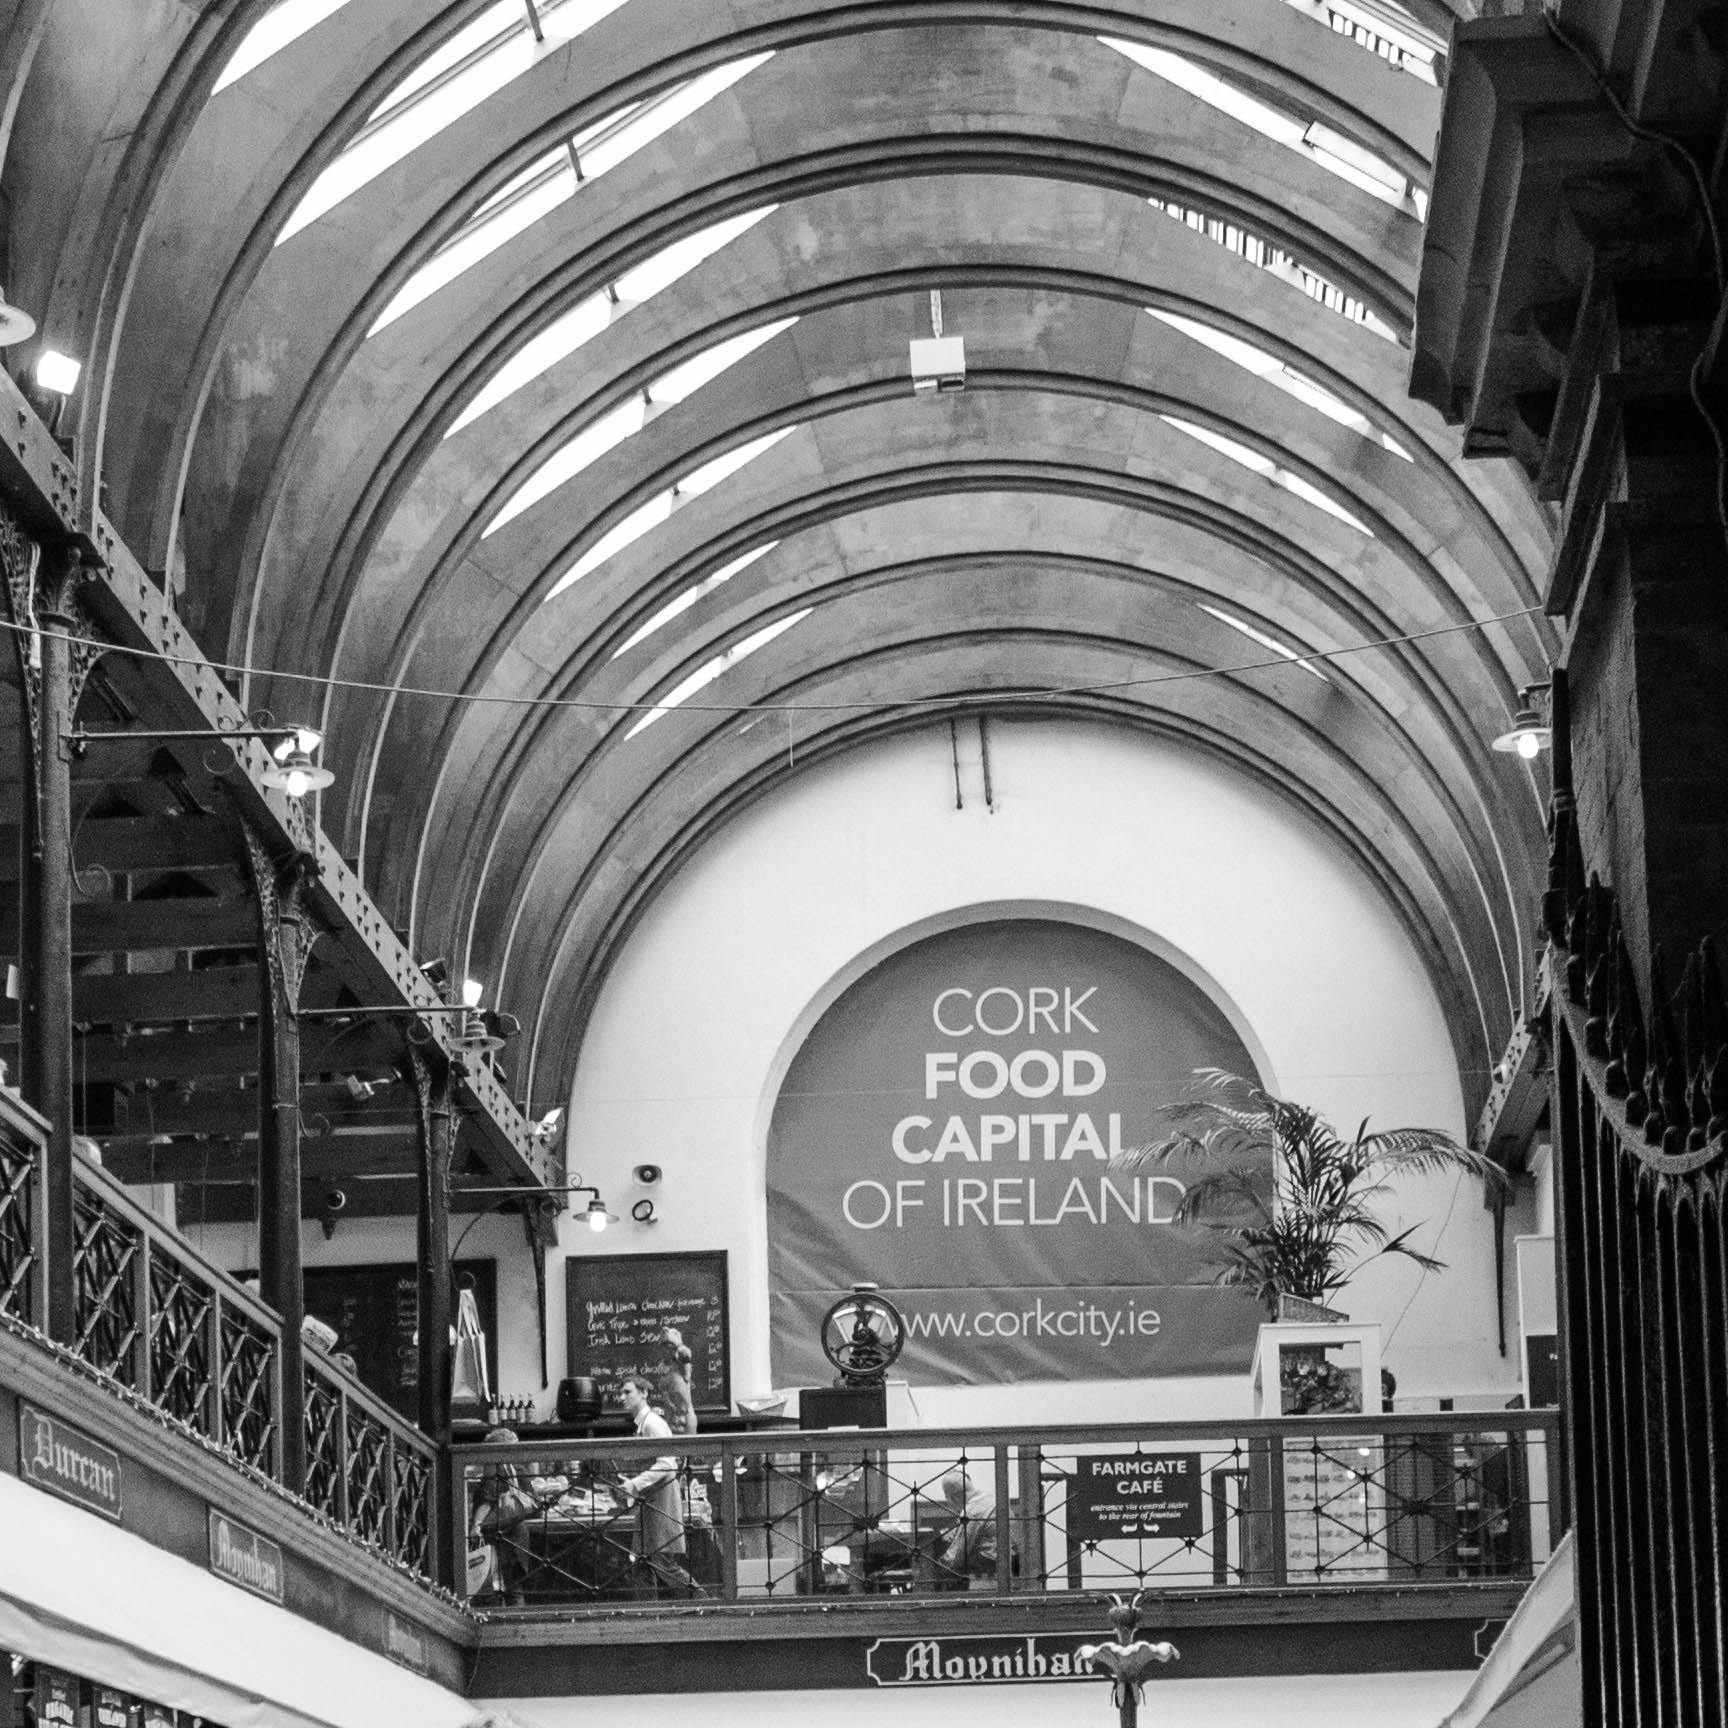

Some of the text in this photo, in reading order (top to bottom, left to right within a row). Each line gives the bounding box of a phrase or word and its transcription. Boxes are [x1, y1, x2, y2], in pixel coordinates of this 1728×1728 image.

[932, 986, 1100, 1037] CORK
[925, 1049, 1108, 1100] FOOD
[842, 1175, 1188, 1230] OF IRELAND
[1092, 1460, 1188, 1476] FARMGATE
[1117, 1477, 1164, 1494] CAFÉ
